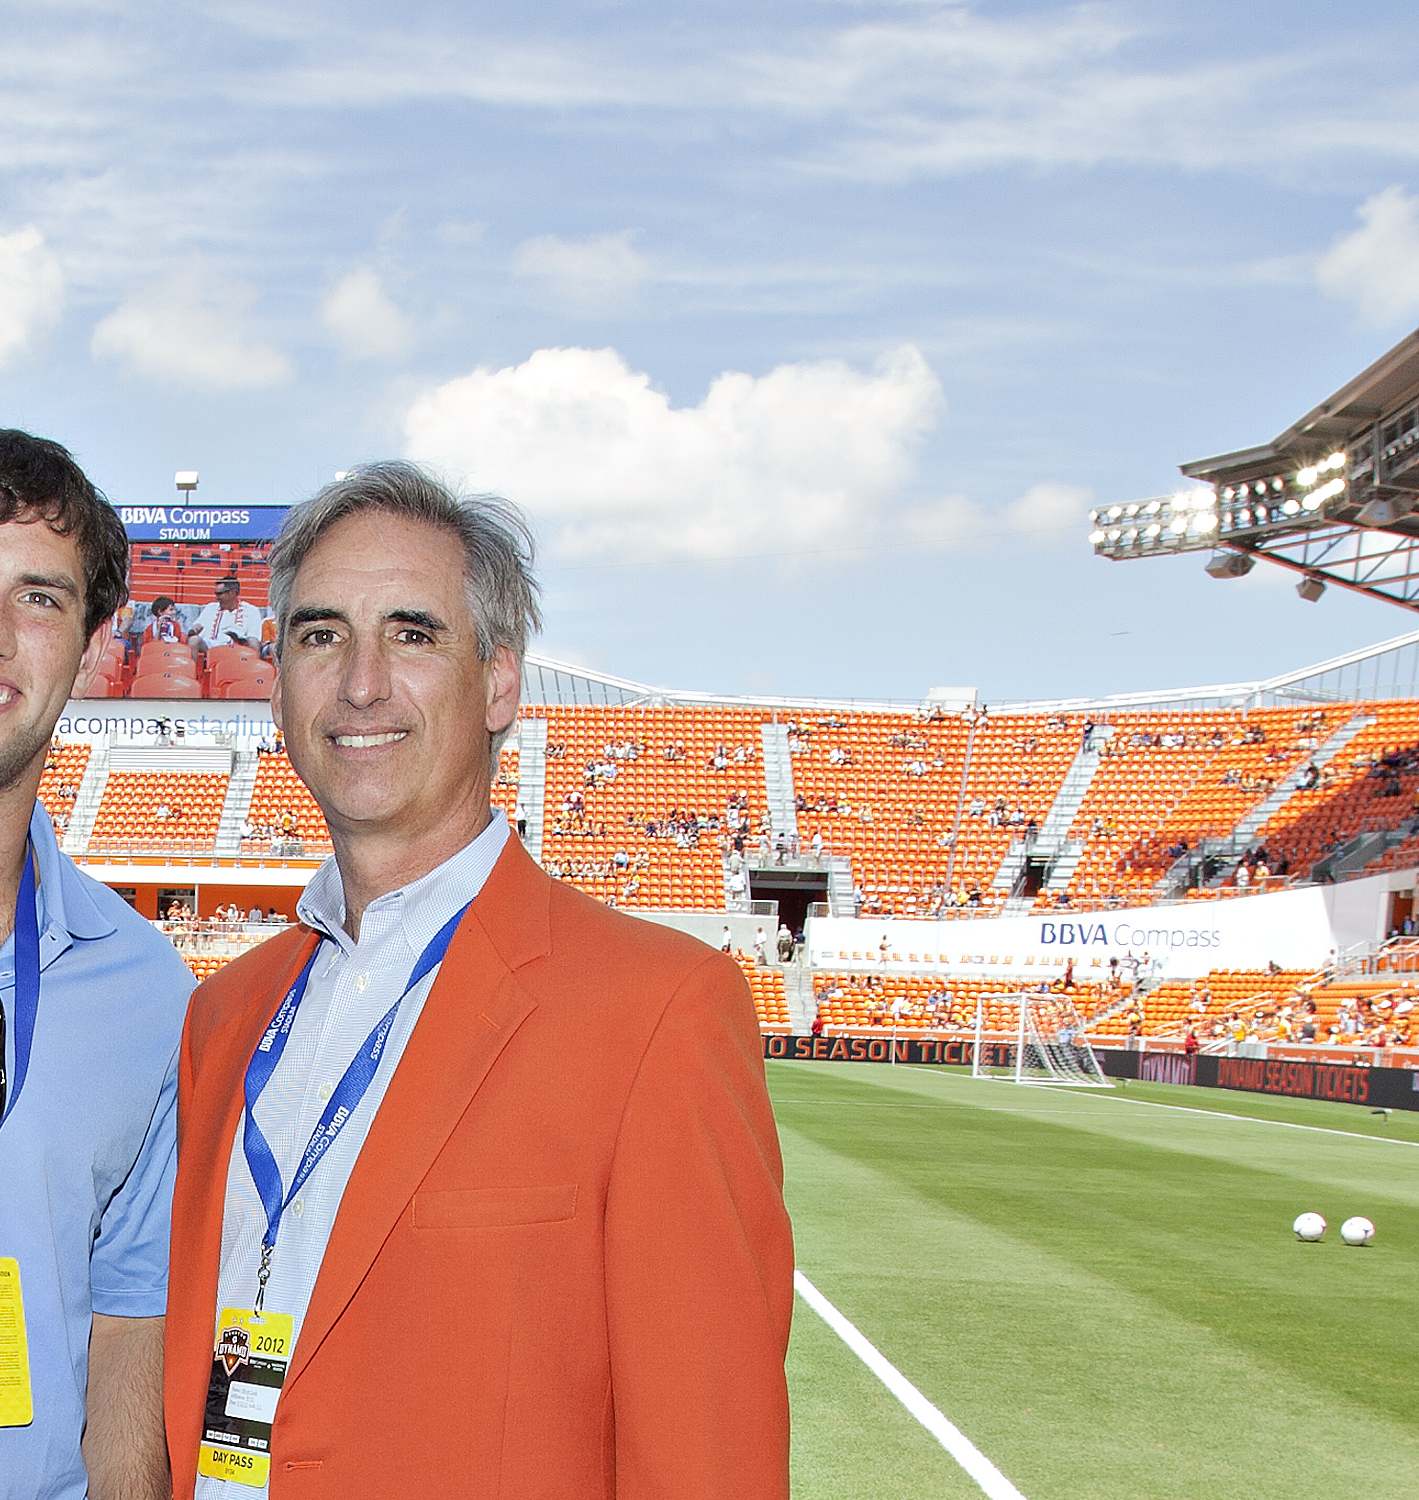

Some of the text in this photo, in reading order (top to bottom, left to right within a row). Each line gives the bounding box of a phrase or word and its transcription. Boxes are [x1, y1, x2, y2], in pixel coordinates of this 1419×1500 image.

[121, 508, 250, 527] BBVA Compass
[159, 528, 211, 540] STADIUM
[1040, 923, 1221, 950] BBVA Compass
[370, 1016, 393, 1061] ompass
[795, 1037, 909, 1063] SEASON
[1218, 1058, 1370, 1101] DYNAMO SEASON TICKETS
[325, 1106, 350, 1138] BBVA
[256, 1335, 284, 1354] 2012
[212, 1450, 254, 1469] DAY PASS
